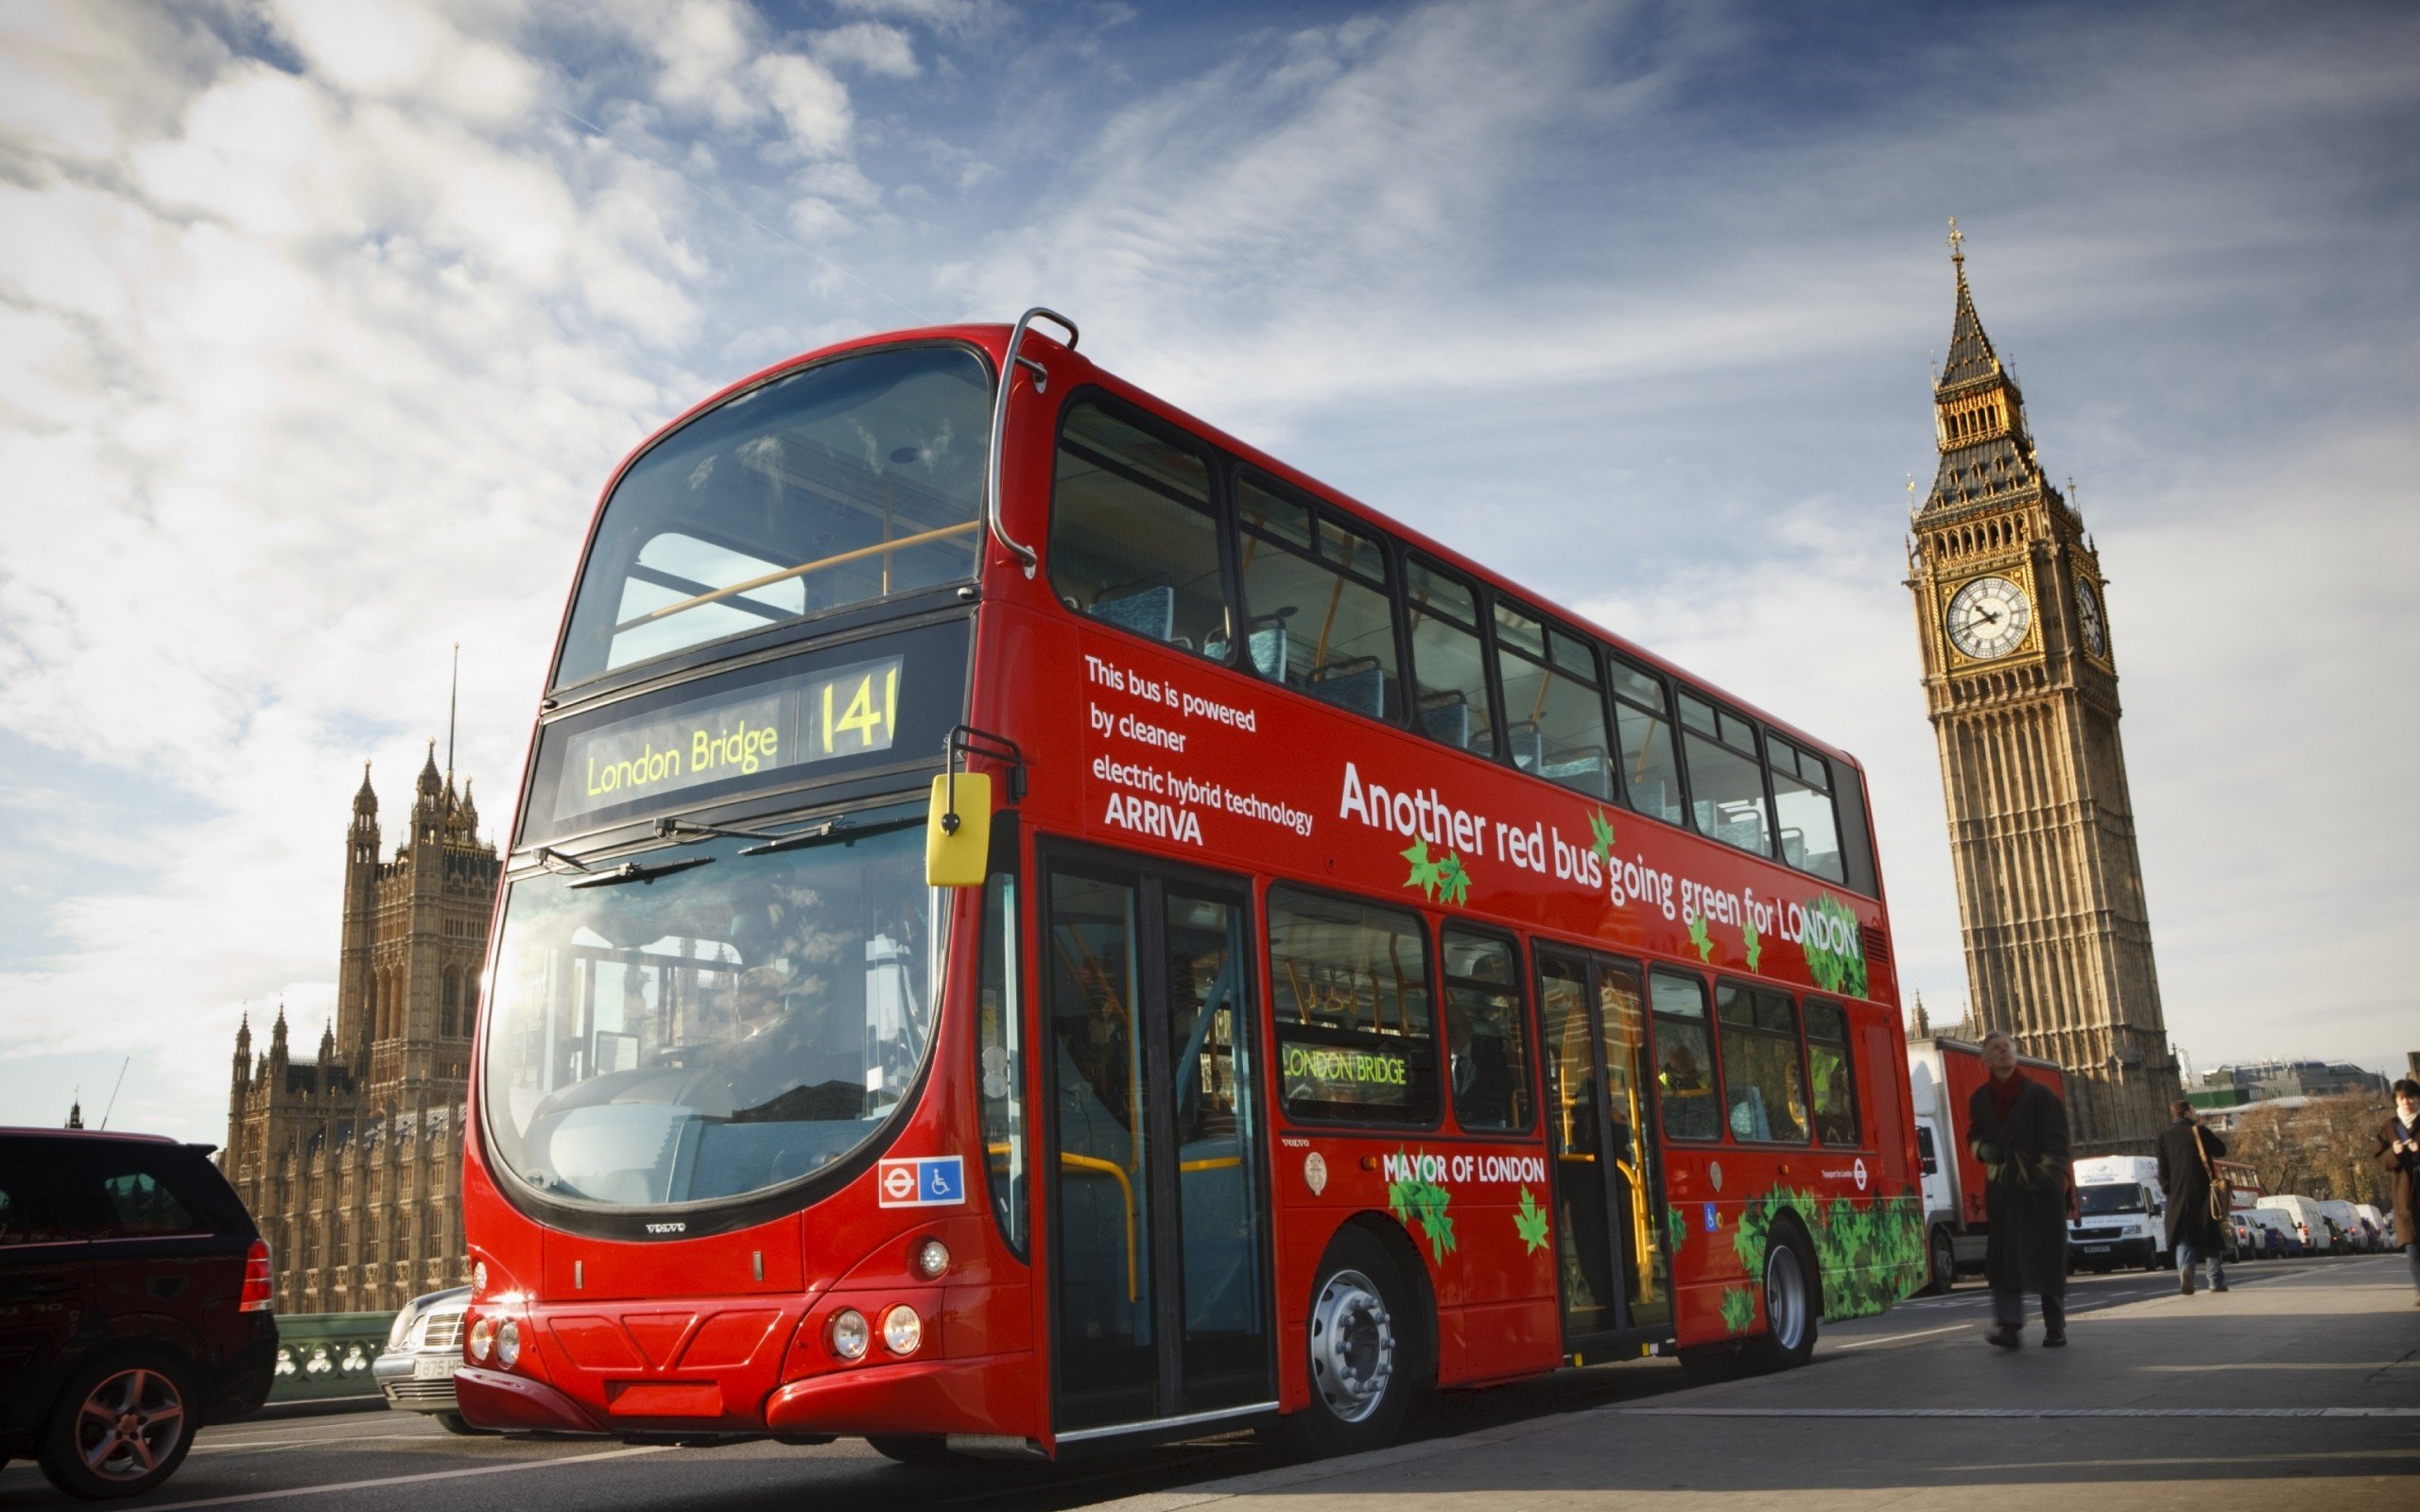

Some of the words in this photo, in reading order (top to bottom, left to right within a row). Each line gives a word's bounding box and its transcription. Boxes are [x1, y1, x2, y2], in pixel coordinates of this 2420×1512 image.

[821, 667, 897, 754] 141
[1085, 654, 1125, 691] This
[1128, 669, 1162, 703] bus
[1164, 680, 1180, 708] is
[1183, 693, 1256, 732] powered
[1090, 701, 1115, 738] by
[1118, 713, 1186, 753] cleaner
[587, 743, 680, 797] London
[691, 720, 779, 775] Bridge
[1092, 754, 1165, 794] electric
[1167, 770, 1221, 809] hybrid
[1224, 788, 1313, 836] technology
[1104, 792, 1203, 847] ARRIVA
[1339, 762, 1487, 856] Another
[1495, 820, 1547, 874] red
[1551, 826, 1603, 888] bus
[1609, 852, 1676, 920] going
[1681, 878, 1741, 926] green
[1744, 887, 1773, 936] for
[1776, 898, 1858, 960] LONDON
[1282, 1047, 1354, 1081] LONDON
[1357, 1055, 1407, 1086] BRIDGE
[1281, 1139, 1310, 1147] VOLVO
[1382, 1154, 1448, 1182] MAYOR
[1452, 1155, 1474, 1182] OF
[1478, 1156, 1546, 1183] LONDON
[646, 1222, 686, 1234] VOLVO
